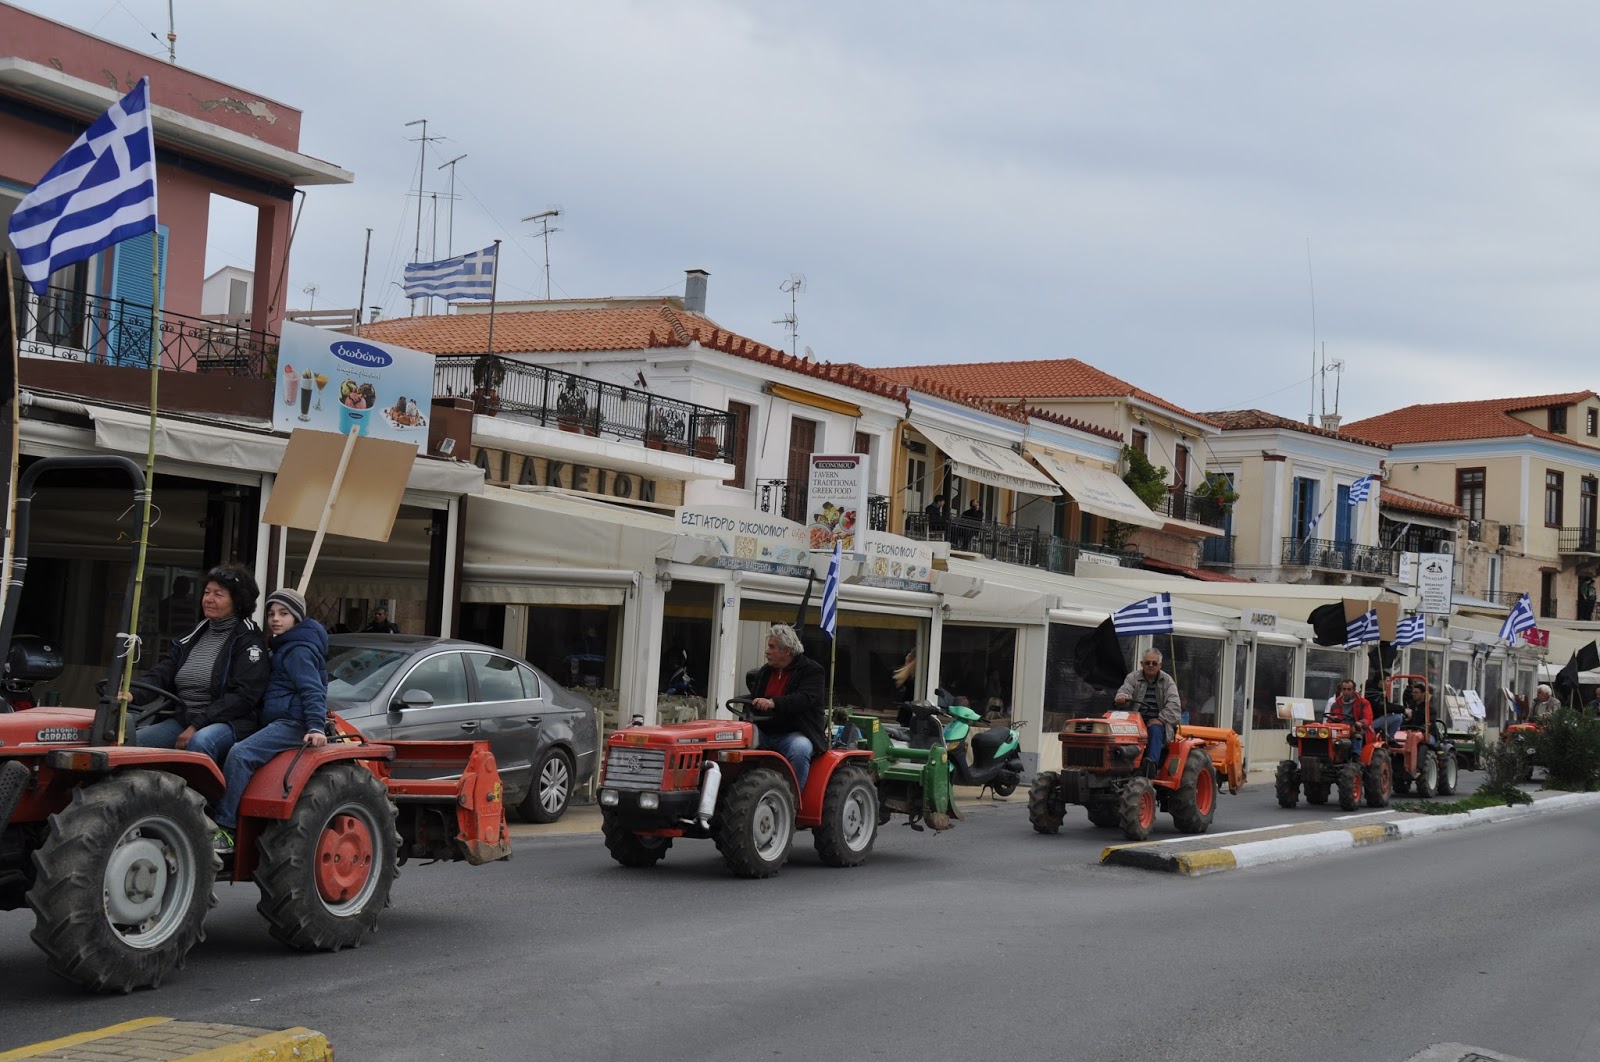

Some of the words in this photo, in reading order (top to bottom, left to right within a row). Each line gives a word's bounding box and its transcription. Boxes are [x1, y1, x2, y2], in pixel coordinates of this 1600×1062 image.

[337, 344, 385, 365] δωδώνη
[474, 449, 657, 503] ΑΙΑΚΕΙΟΝ
[813, 479, 858, 487] TRADITIONAL
[967, 465, 1001, 482] BREAKFAST
[1005, 474, 1025, 488] LUNCH
[1029, 480, 1051, 492] DINNER
[681, 511, 735, 532] ΕΣΤΙΑΤΟΡΙΟ
[37, 730, 79, 741] CARRARO
